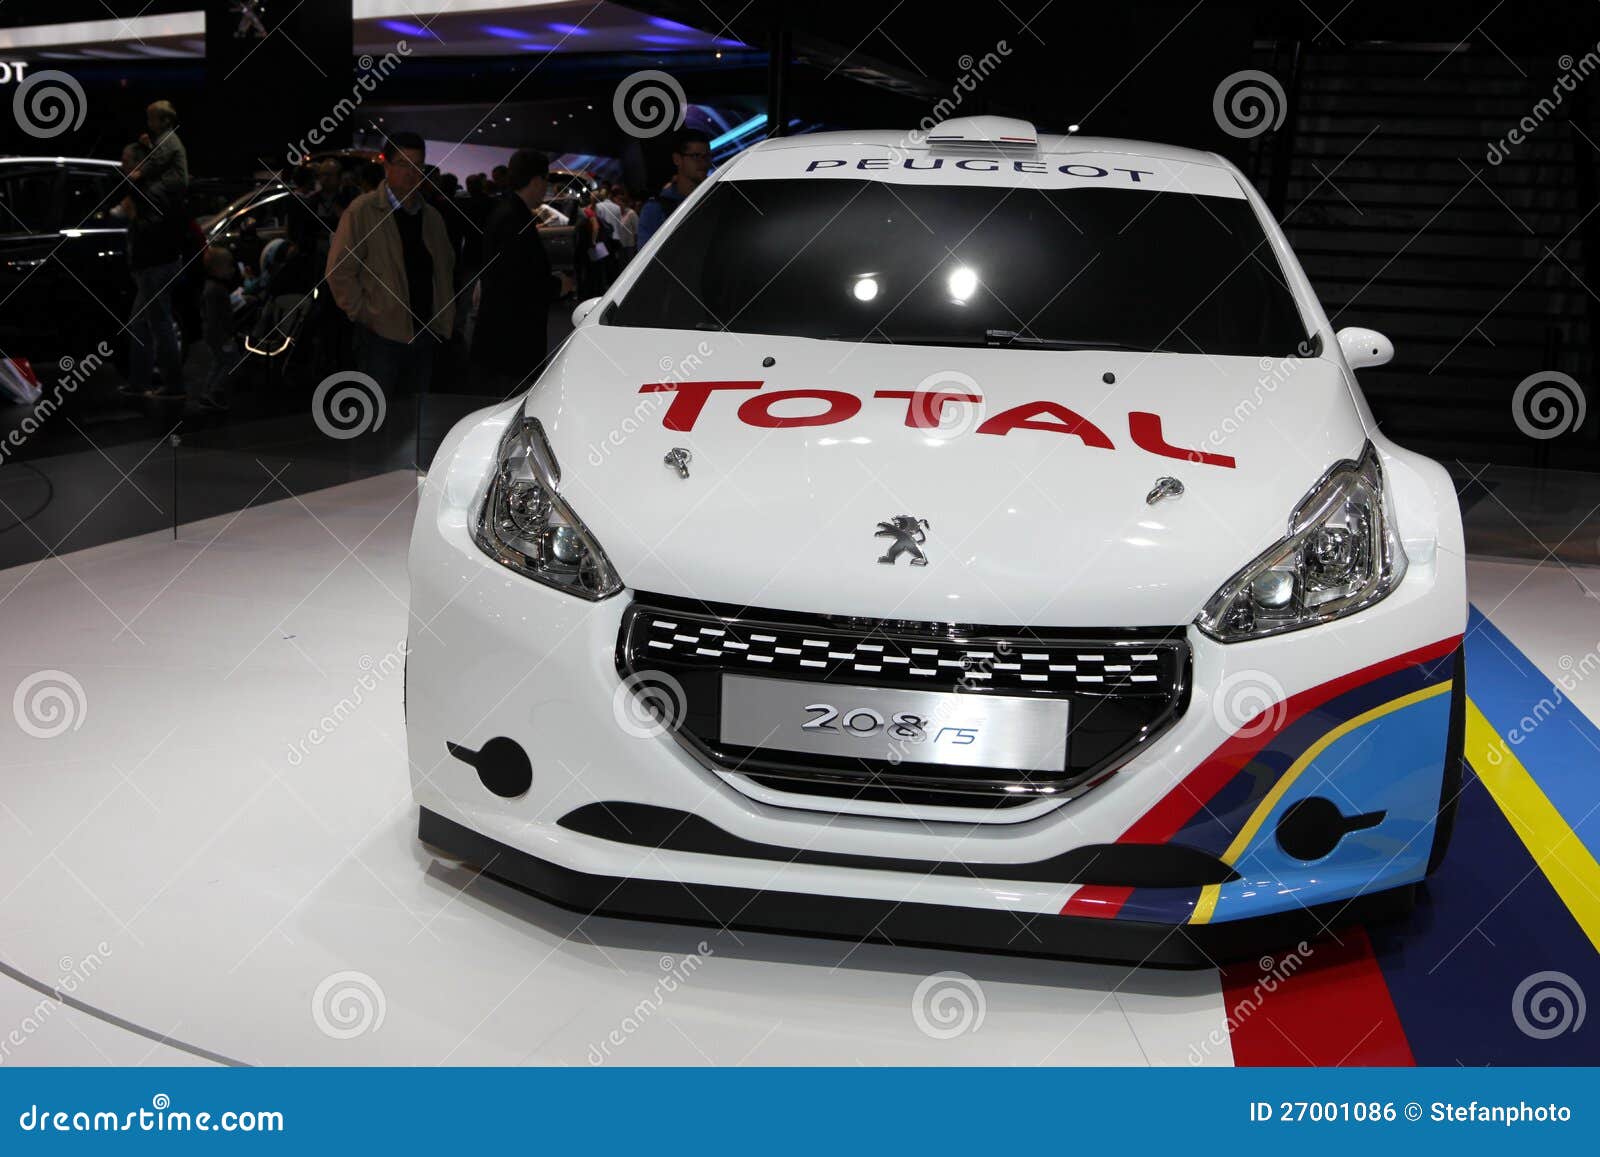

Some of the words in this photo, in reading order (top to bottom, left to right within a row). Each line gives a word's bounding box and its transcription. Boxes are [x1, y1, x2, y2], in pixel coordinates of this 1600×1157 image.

[805, 158, 1155, 183] PEUGEOT
[638, 380, 1236, 469] TOTAL
[801, 703, 928, 743] 208
